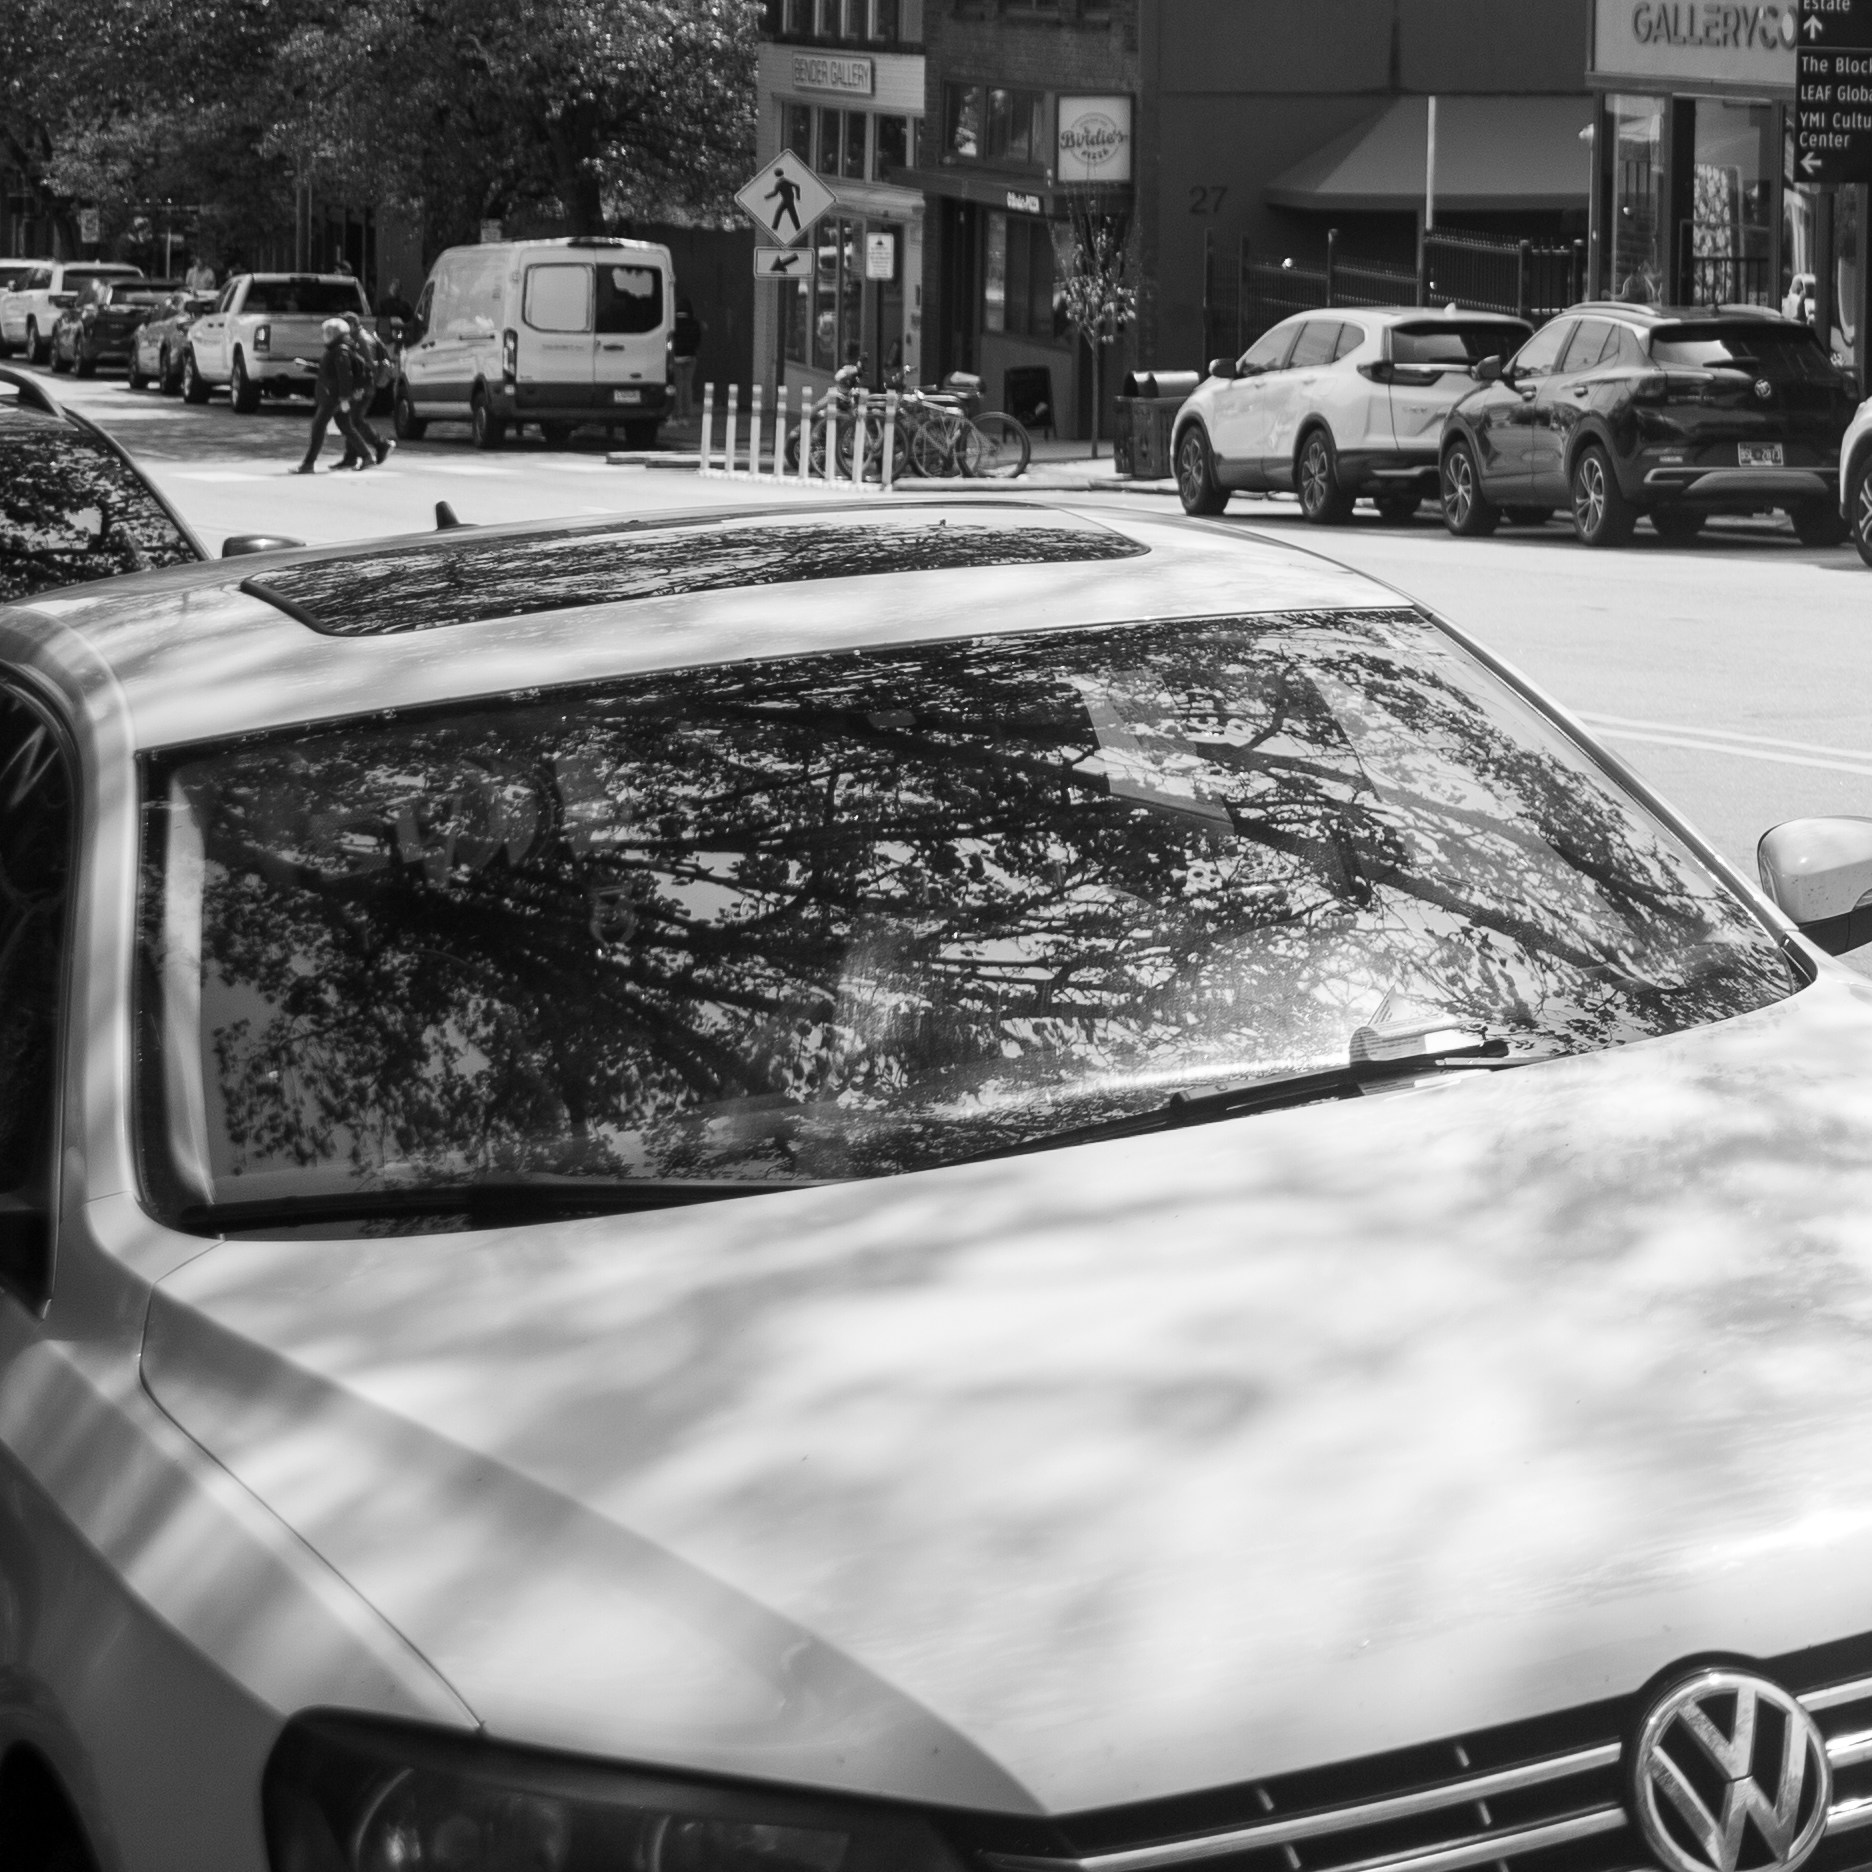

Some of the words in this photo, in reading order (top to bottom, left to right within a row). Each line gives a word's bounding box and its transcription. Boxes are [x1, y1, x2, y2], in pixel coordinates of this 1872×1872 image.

[1801, 56, 1828, 72] The
[794, 58, 828, 84] BENDER
[831, 61, 869, 89] GALLERY
[1801, 84, 1831, 101] LEAF
[1800, 111, 1825, 128] YMI
[1060, 126, 1126, 149] Birdie's
[1799, 131, 1850, 149] Center
[1189, 186, 1228, 215] 27
